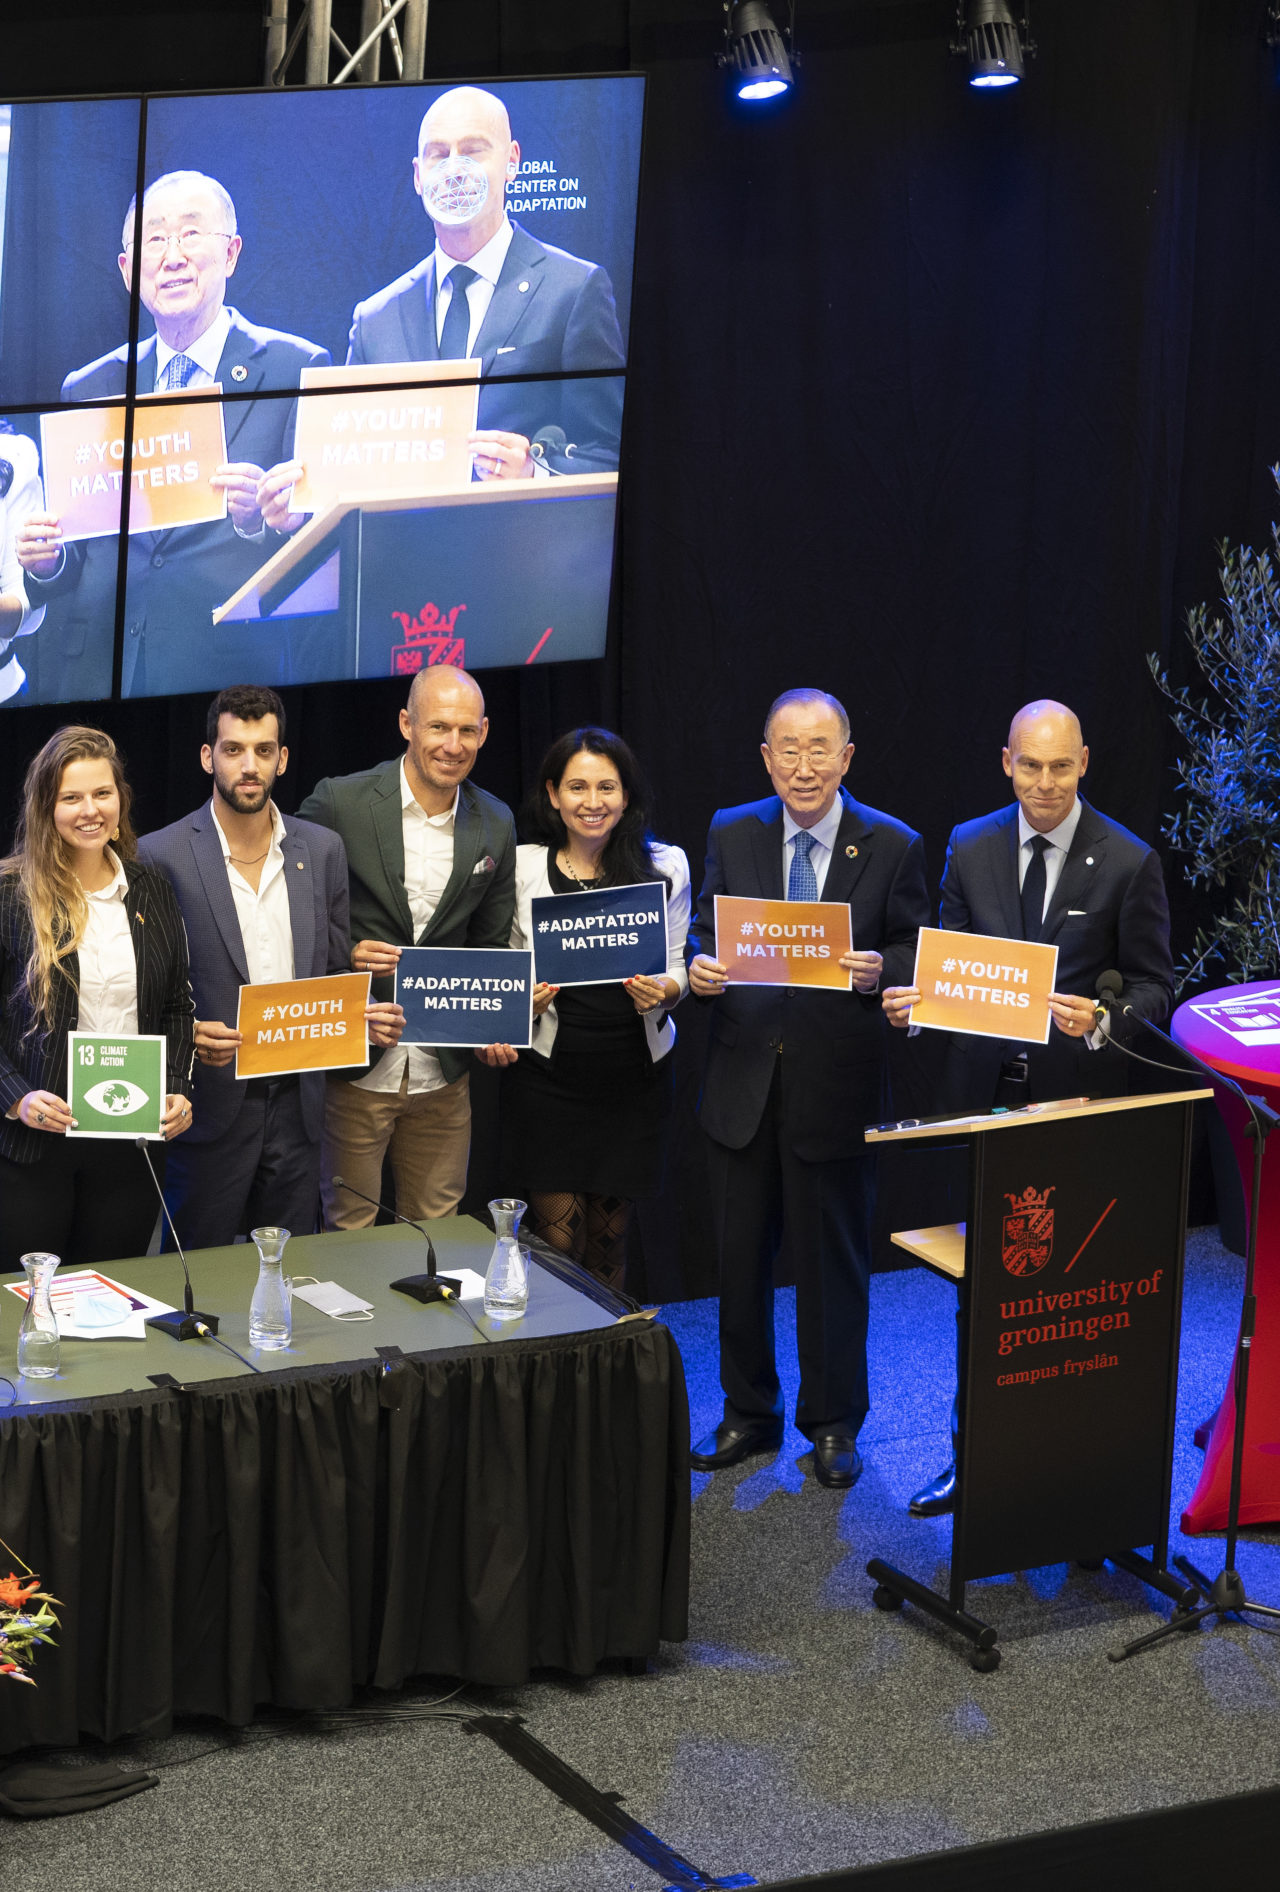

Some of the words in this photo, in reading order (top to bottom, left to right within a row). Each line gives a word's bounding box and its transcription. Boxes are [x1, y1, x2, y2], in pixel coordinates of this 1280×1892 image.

[506, 160, 557, 175] GLOBAL
[505, 179, 557, 194] CENTER
[559, 177, 579, 192] ON
[504, 196, 587, 213] ADAPTATION
[330, 405, 445, 433] #YOUTH
[74, 431, 191, 464] #YOUTH
[322, 438, 447, 466] MATTERS
[70, 460, 200, 497] MATTERS
[537, 911, 660, 933] #ADAPTATION
[740, 921, 825, 938] #YOUTH
[561, 932, 639, 951] MATTERS
[735, 943, 831, 959] MATTERS
[941, 957, 1029, 985] #YOUTH
[401, 976, 526, 993] #ADAPTATION
[934, 980, 1031, 1009] MATTERS
[262, 998, 344, 1022] #YOUTH
[424, 996, 503, 1011] MATTERS
[256, 1020, 347, 1045] MATTERS
[78, 1044, 95, 1066] 13
[100, 1045, 128, 1056] CLIMATE
[100, 1056, 125, 1067] ACTION
[999, 1279, 1134, 1320] university
[1136, 1269, 1164, 1295] of
[997, 1310, 1131, 1356] groningen
[996, 1363, 1059, 1387] campus
[1063, 1353, 1120, 1376] fryslân
